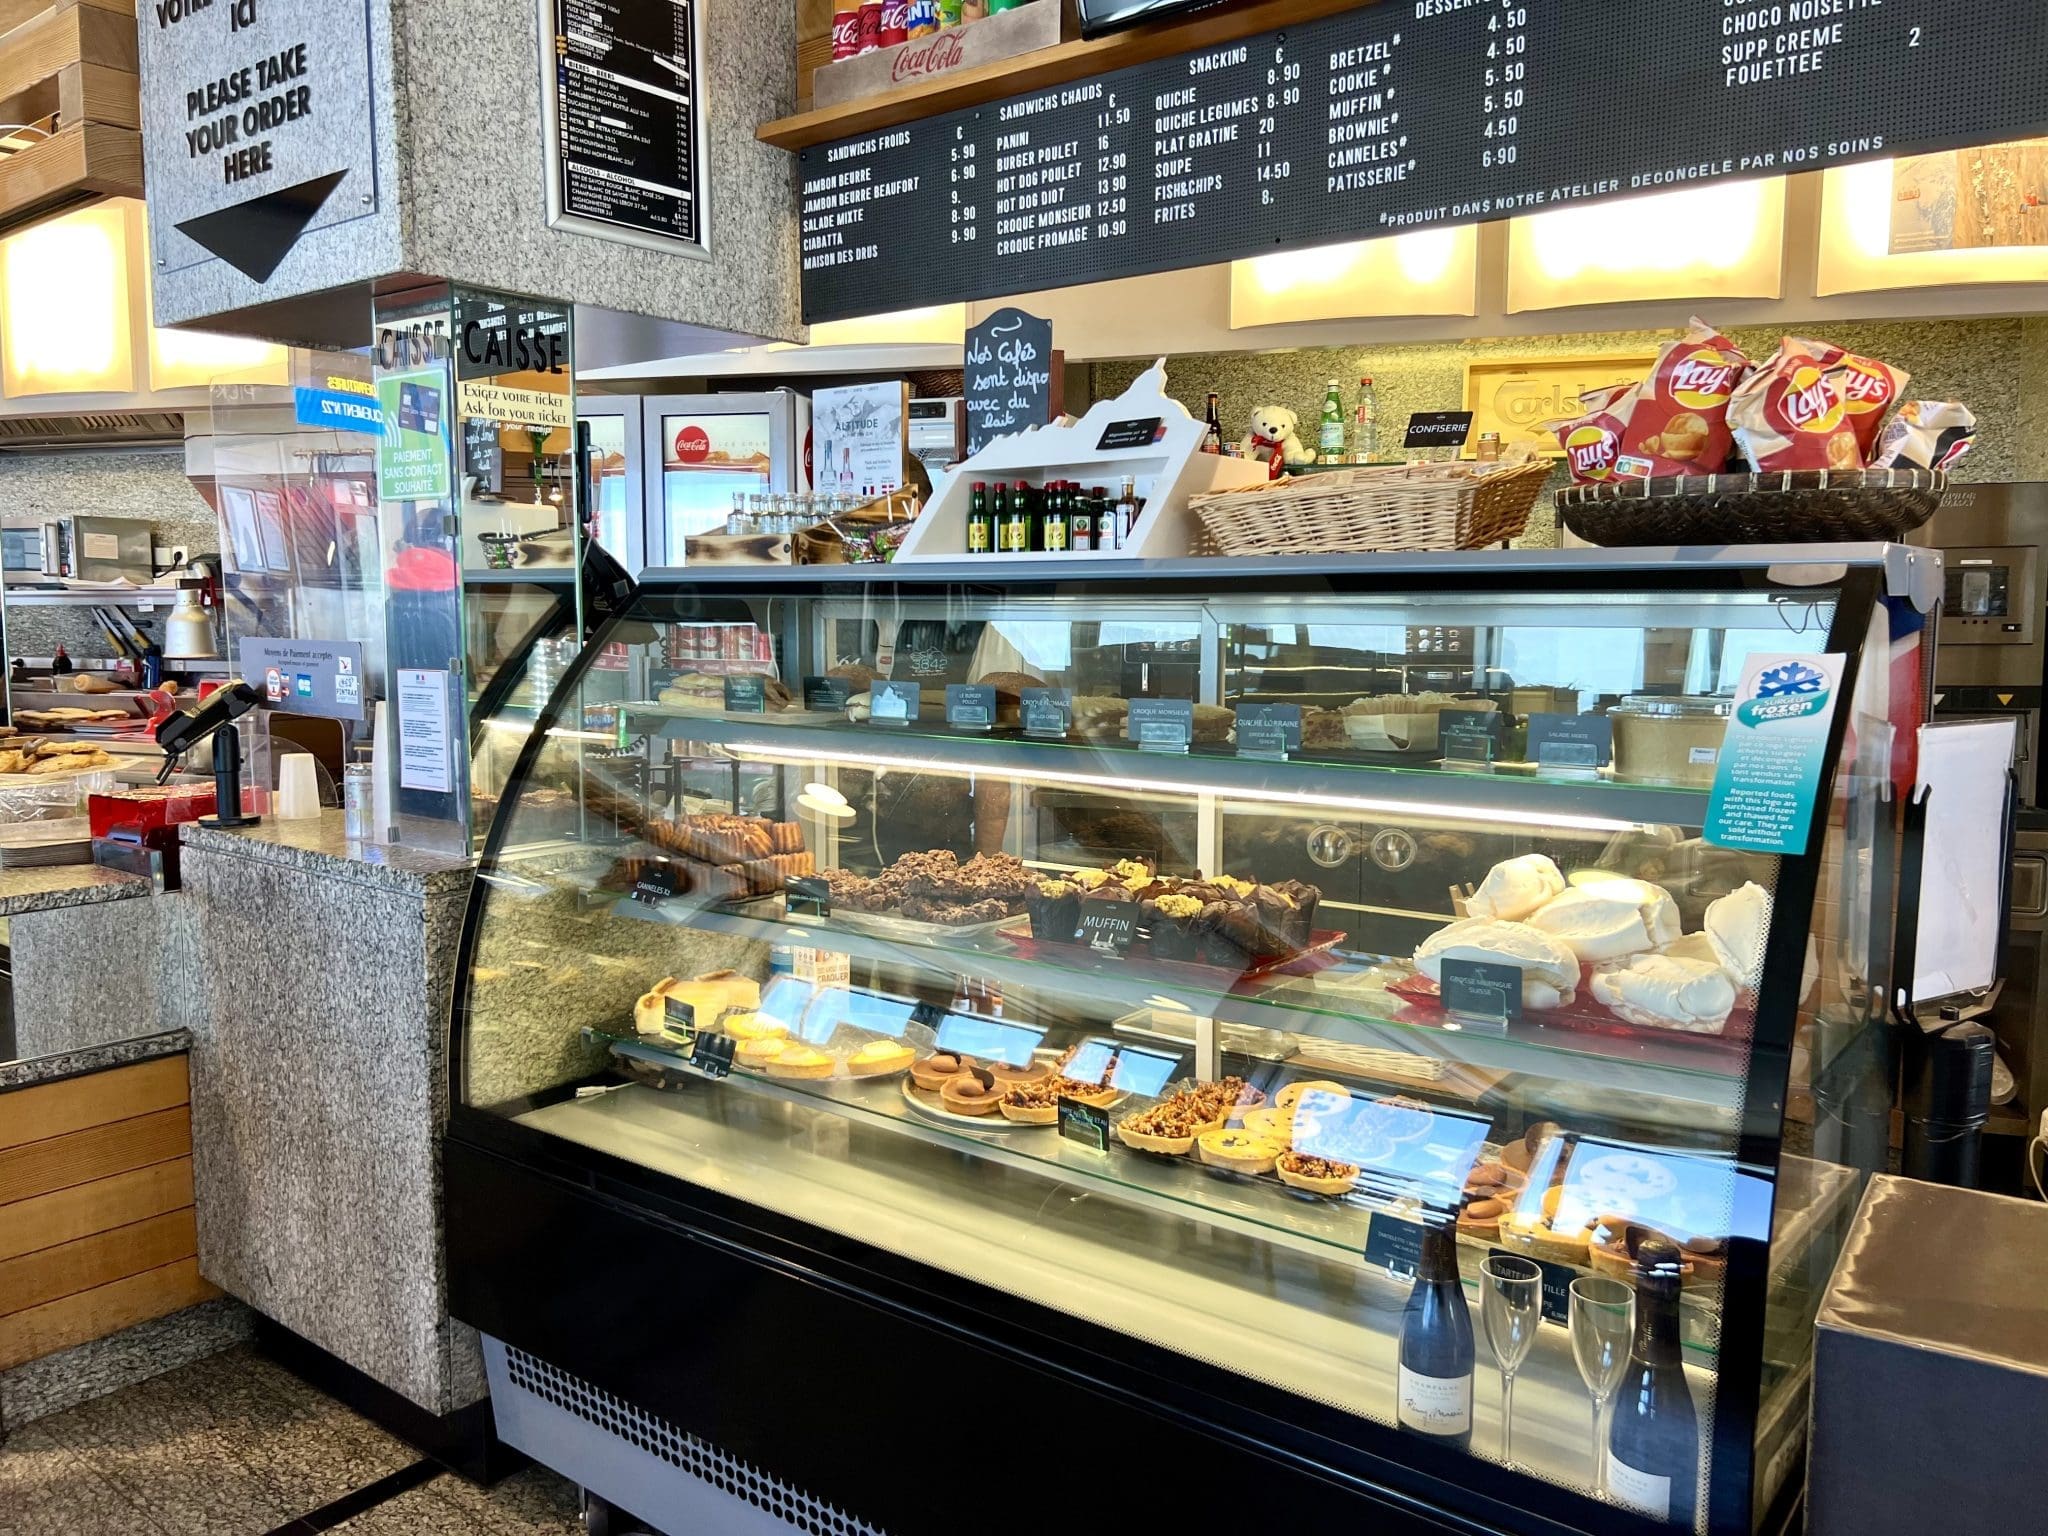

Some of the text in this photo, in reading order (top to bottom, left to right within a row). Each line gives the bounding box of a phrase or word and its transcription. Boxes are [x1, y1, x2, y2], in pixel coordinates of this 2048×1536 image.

[1723, 6, 1781, 35] CHOCO
[891, 28, 969, 83] Coca-Cola
[1722, 23, 1920, 64] SUPP CREME 2
[1190, 47, 1246, 75] SNACKING
[1726, 51, 1823, 88] FOUETTEE
[187, 43, 307, 121] PLEASE TAKE
[1000, 94, 1057, 121] SANDWICHS
[1062, 83, 1102, 106] CHAUDS
[1156, 88, 1196, 110] QUICHE
[186, 85, 312, 158] YOUR ORDER
[1156, 111, 1196, 133] QUICHE
[1200, 97, 1258, 123] LEGUMES
[1484, 117, 1517, 138] 4.50
[828, 139, 876, 162] SANDWICHS
[879, 131, 910, 150] FROIDS
[997, 131, 1028, 151] PANINI
[1156, 117, 1274, 156] PLAT GRATINE 20
[224, 141, 273, 184] HERE
[997, 135, 1108, 172] BURGER POULET 16
[1155, 142, 1270, 178] SOUPE 11
[1483, 146, 1516, 167] 6.90
[571, 164, 636, 186] ALCOOLS ALCOHOL
[803, 168, 871, 194] JAMBON BEURRE
[997, 153, 1126, 193] HOT DOG POULET 12.90
[1155, 162, 1289, 201] FISH&CHIPS 14.50
[1380, 136, 1882, 227] #PRODUIT DANS NOTRE ATELIER DECONGELE PAR NOS SOINS
[803, 177, 919, 213] JAMBON BEURRE BEAUFORT
[997, 197, 1016, 214] HOT
[1019, 193, 1038, 209] DOG
[1041, 188, 1064, 205] DIOT
[803, 209, 863, 232] SALADE MIXTE
[997, 197, 1126, 234] CROQUE MONSIEUR 12.50
[1155, 203, 1195, 223] FRITES
[804, 232, 843, 251] CIABATTA
[997, 220, 1126, 255] CROQUE FROMAGE 10.90
[804, 245, 877, 269] MAISON DES DRUS
[380, 320, 445, 370] CAISSE
[464, 320, 563, 374] CAISSE
[967, 337, 993, 365] Nos
[972, 368, 1050, 394] sont dispo
[1672, 361, 1731, 396] Lay's
[464, 401, 485, 415] Ask
[966, 391, 1030, 412] avec du
[1788, 374, 1835, 425] Lay's
[834, 418, 878, 432] ALTITUDE
[1409, 423, 1468, 435] CONFISERIE
[393, 448, 433, 463] PAIEMENT
[384, 463, 443, 479] SANS CONTACT
[1133, 708, 1156, 716] CROQUE
[1750, 701, 1813, 716] frozen
[1238, 719, 1299, 728] QUICHE LORRAINE
[1730, 787, 1795, 799] Reported foods
[1745, 796, 1761, 804] this
[1762, 798, 1782, 807] logo
[1722, 803, 1796, 815] purchased frozen
[1725, 811, 1790, 822] and thawed for
[1718, 818, 1794, 831] our They are
[1727, 826, 1782, 837] sold without
[1083, 916, 1130, 931] MUFFIN
